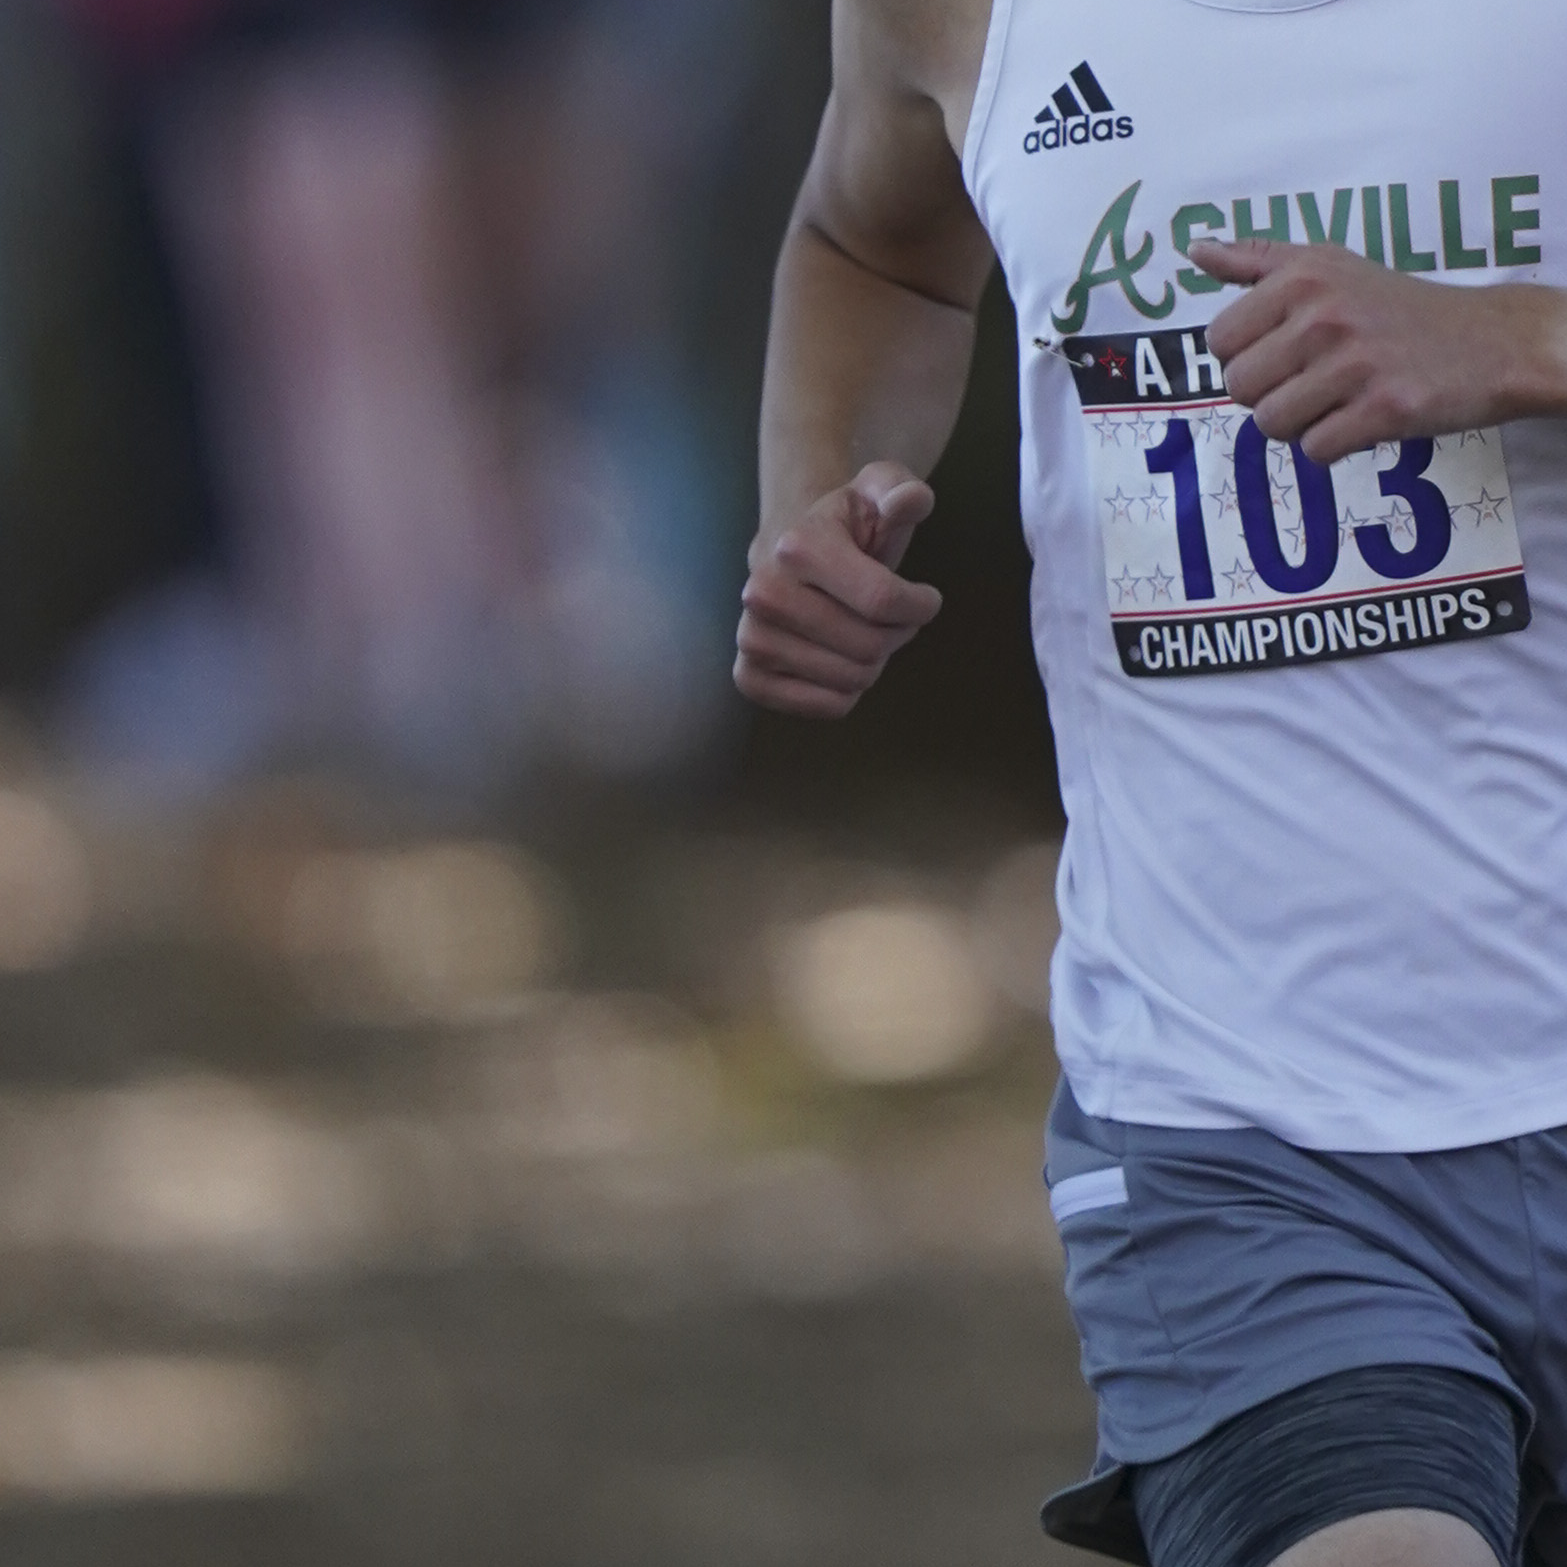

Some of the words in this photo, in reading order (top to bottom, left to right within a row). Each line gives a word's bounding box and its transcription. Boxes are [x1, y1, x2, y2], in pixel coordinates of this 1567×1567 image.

[1023, 114, 1134, 155] adidas
[1144, 414, 1452, 601] 103
[1139, 587, 1491, 670] CHAMPIONSHIPS
